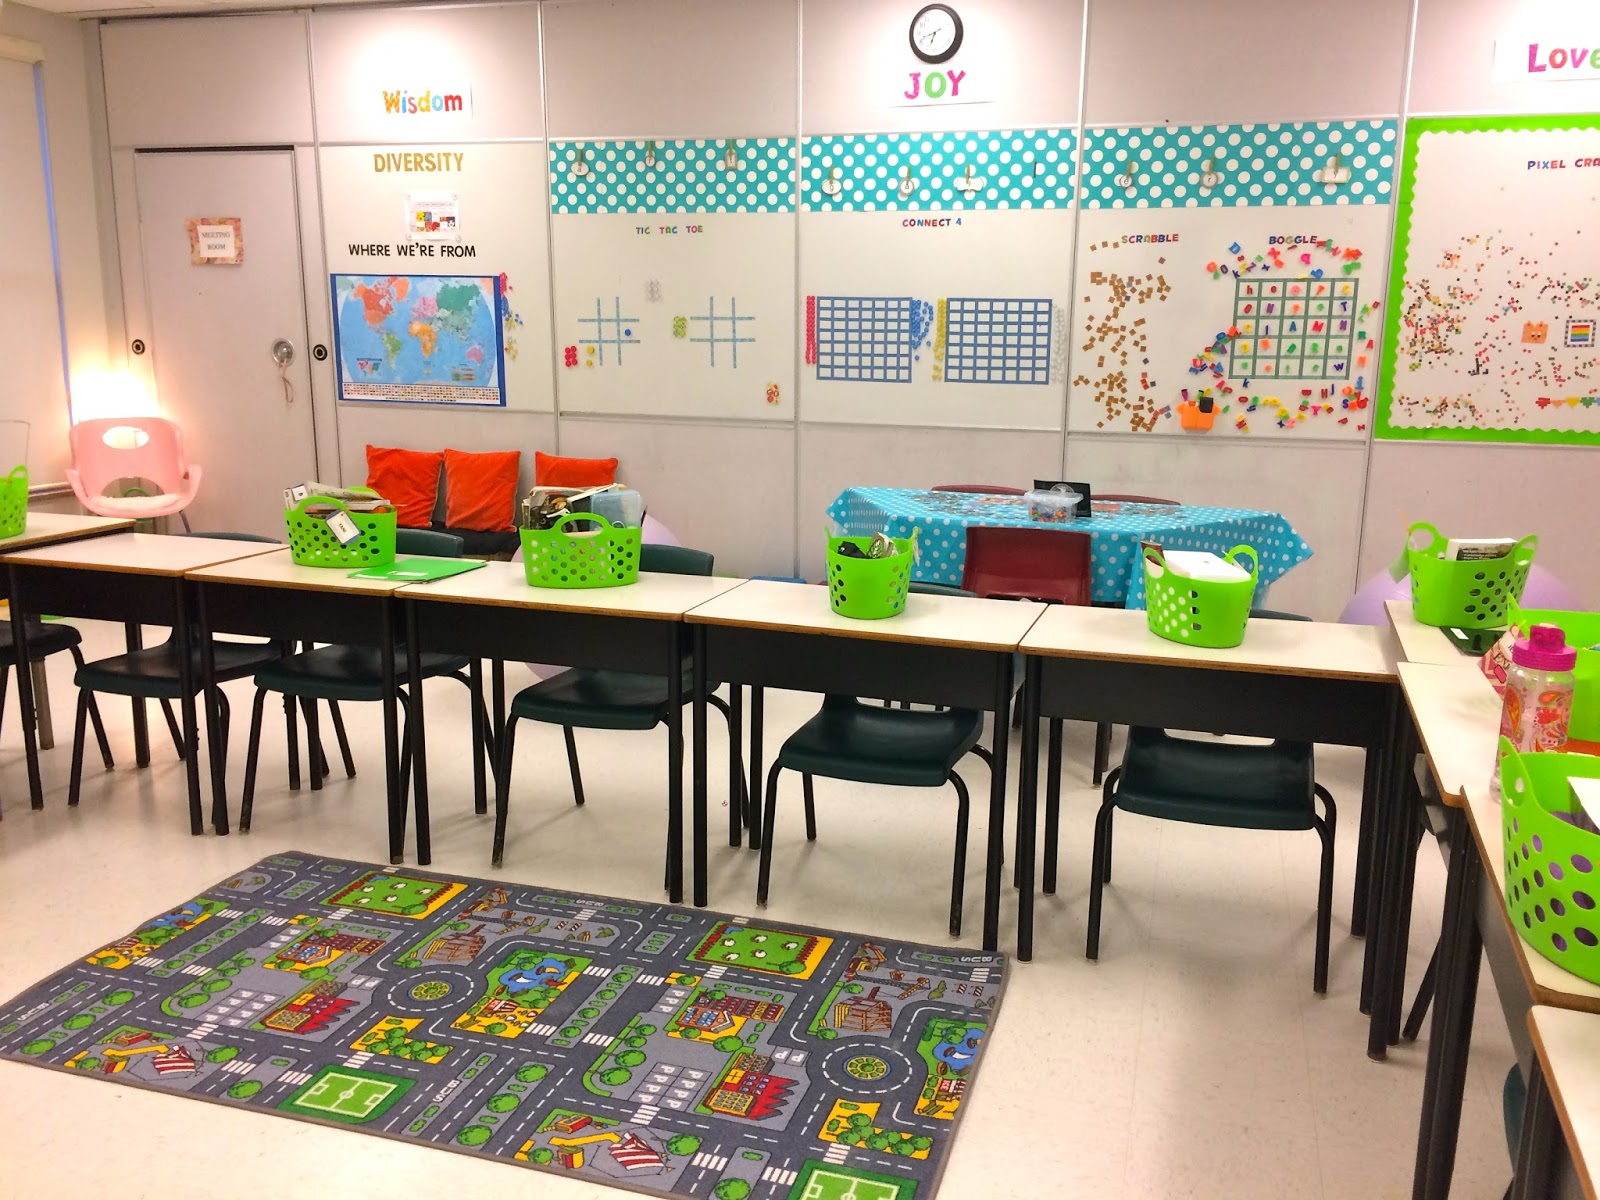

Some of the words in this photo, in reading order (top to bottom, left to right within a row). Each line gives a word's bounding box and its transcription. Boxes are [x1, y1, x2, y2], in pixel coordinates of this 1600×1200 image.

[904, 69, 967, 100] JOY
[382, 89, 463, 114] Wisdom
[373, 152, 464, 173] DIVERSITY
[1527, 160, 1567, 170] PIXEL
[902, 218, 951, 227] CONNECT
[955, 217, 962, 226] 4
[201, 231, 231, 239] MEETING
[635, 226, 651, 235] TIC
[659, 225, 678, 234] TAC
[685, 224, 703, 234] TOE
[1121, 233, 1179, 244] SCRABBLE
[1268, 235, 1318, 245] BOGGLE
[207, 243, 226, 251] ROOM
[348, 243, 391, 257] WHERE
[440, 245, 477, 258] FROM
[672, 989, 685, 997] P
[665, 997, 679, 1005] P
[659, 1005, 673, 1013] P
[774, 1050, 788, 1060] P
[791, 1053, 805, 1063] P
[661, 1065, 675, 1074] P
[688, 1070, 703, 1079] P
[653, 1074, 669, 1083] P
[681, 1080, 696, 1089] P
[432, 1079, 461, 1102] BUS
[645, 1084, 661, 1093] P
[674, 1089, 690, 1098] P
[638, 1093, 654, 1103] P
[666, 1099, 682, 1109] P
